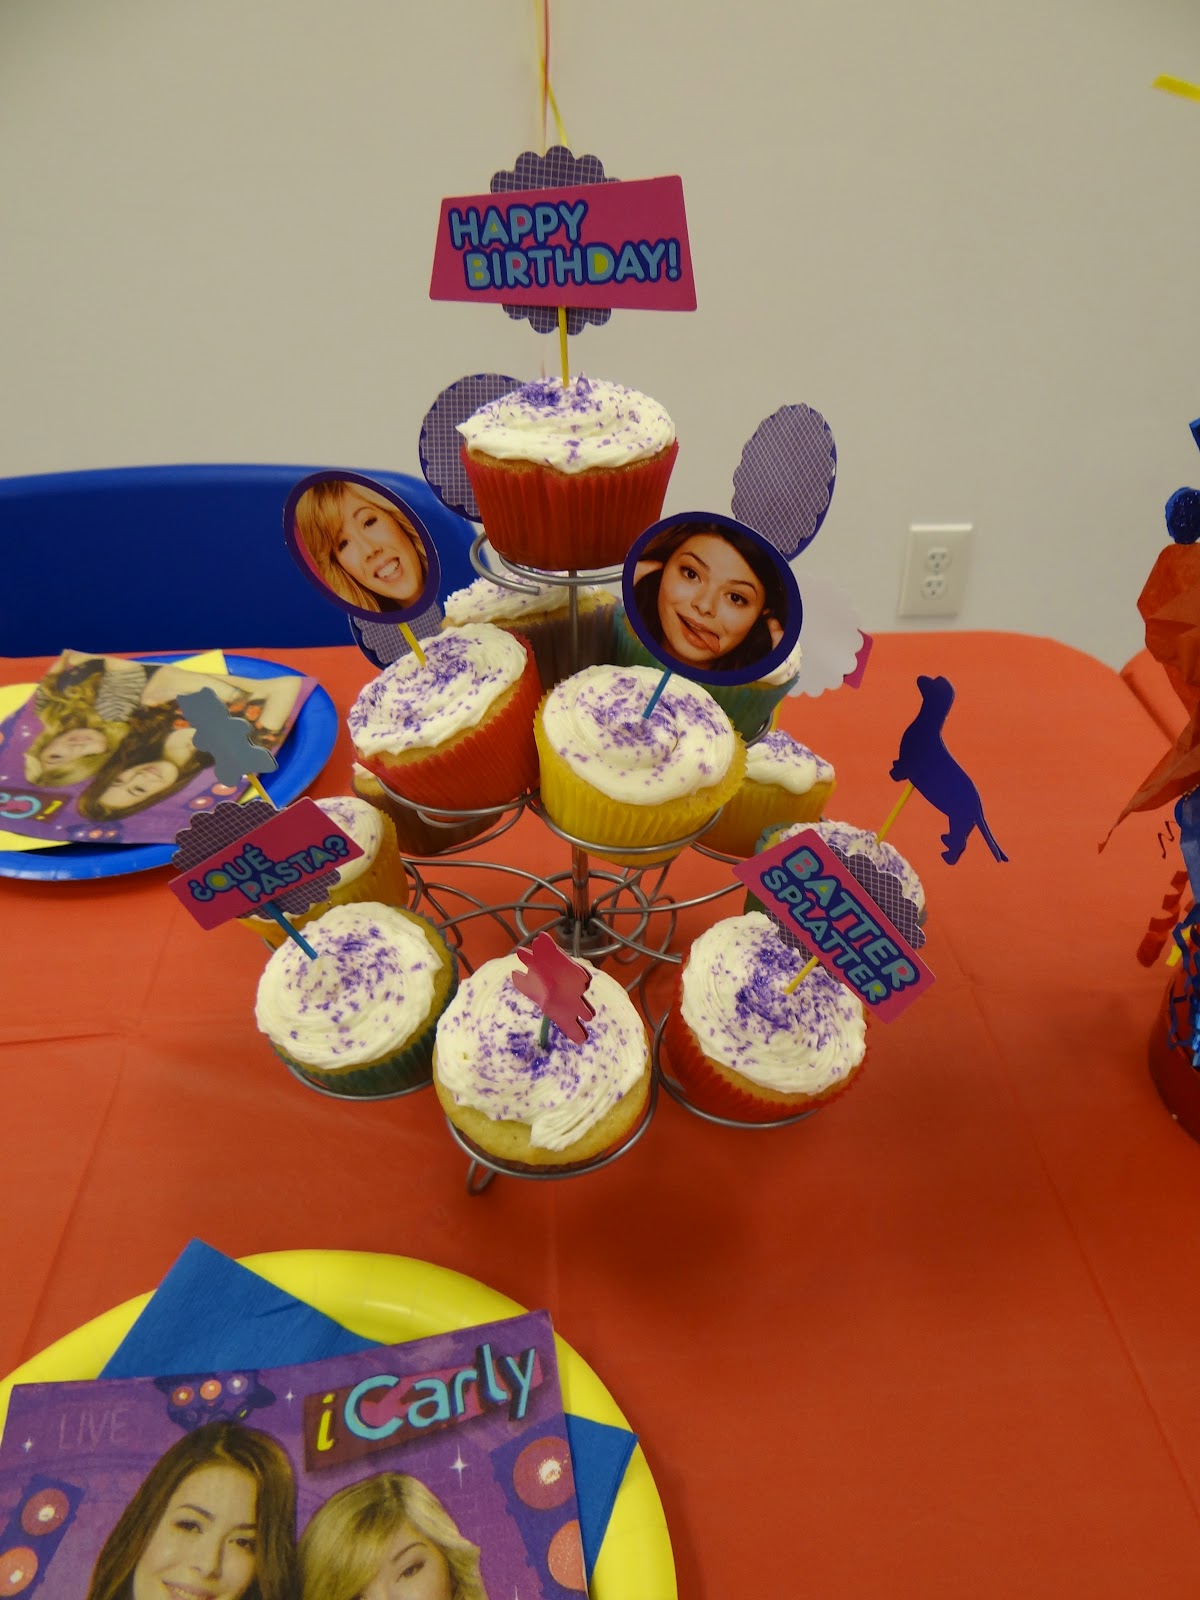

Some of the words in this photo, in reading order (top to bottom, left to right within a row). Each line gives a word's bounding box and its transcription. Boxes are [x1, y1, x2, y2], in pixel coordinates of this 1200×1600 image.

[449, 199, 588, 248] HAPPY
[464, 238, 682, 290] BIRTHDAY!
[237, 835, 350, 903] PASTA?
[760, 866, 892, 1006] SPLATTER
[782, 846, 920, 992] BATTER
[58, 1408, 128, 1451] LIVE
[316, 1343, 537, 1451] iCarly
